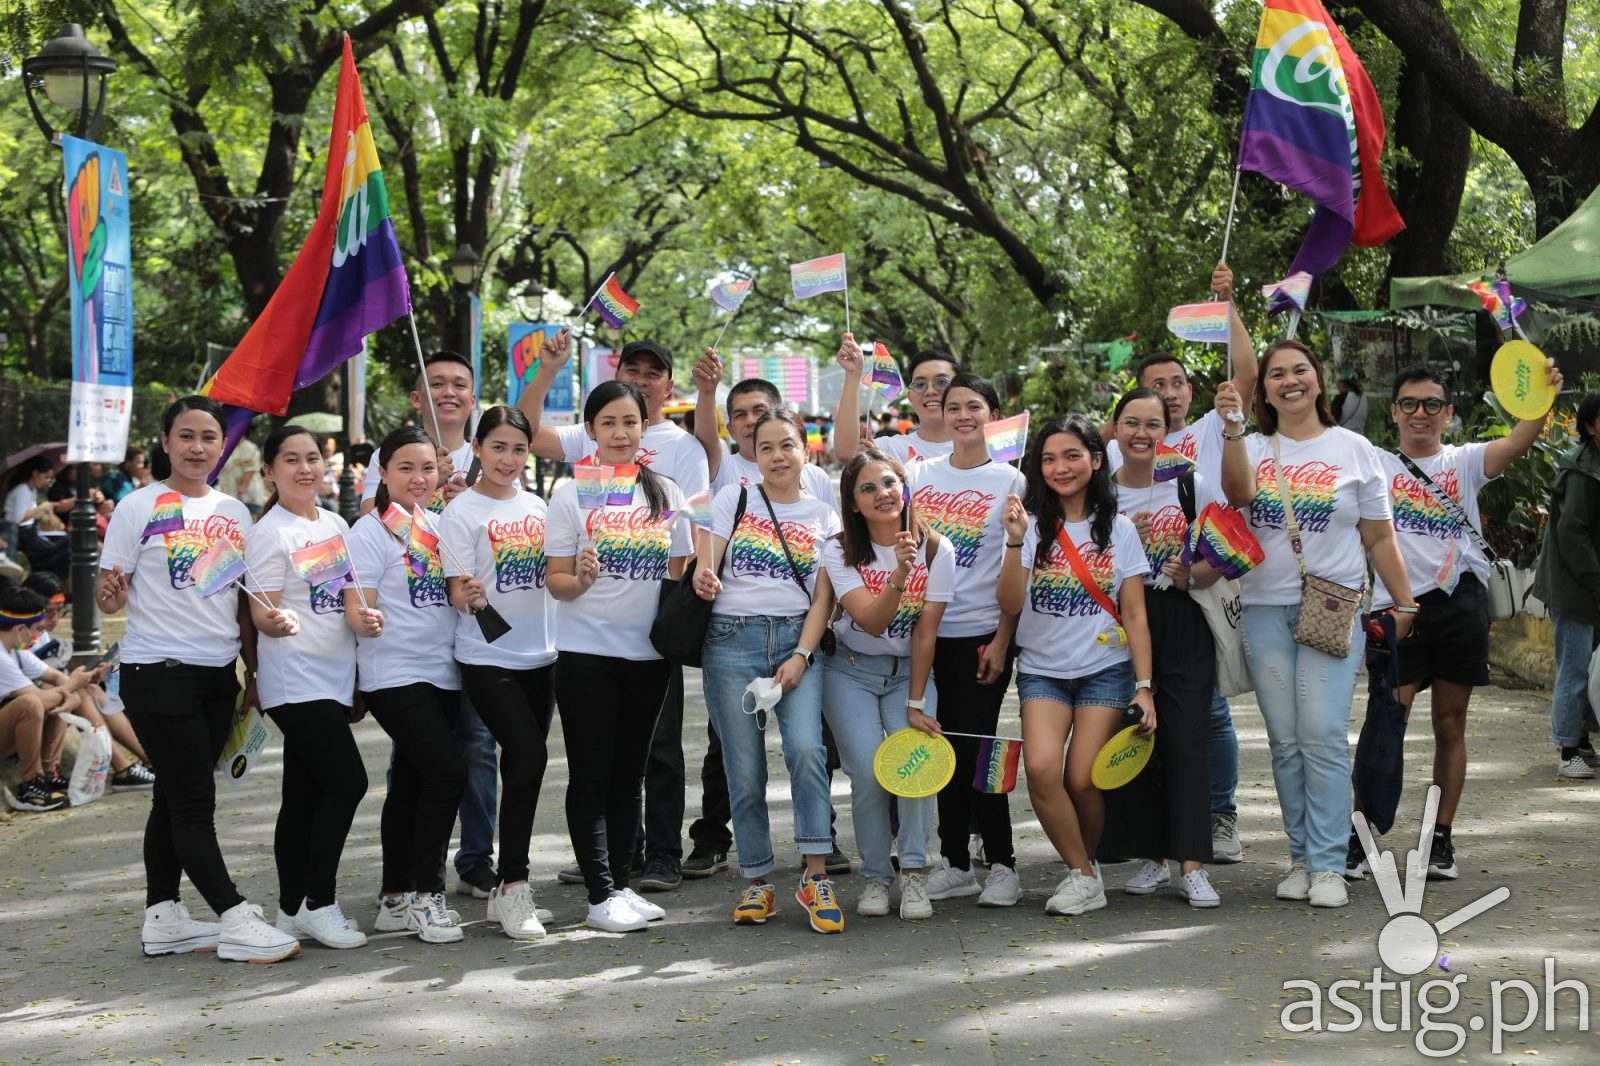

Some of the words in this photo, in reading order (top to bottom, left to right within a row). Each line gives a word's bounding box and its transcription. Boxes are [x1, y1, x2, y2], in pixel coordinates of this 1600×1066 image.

[1256, 458, 1343, 485] Coa-Cola
[488, 515, 544, 542] Coca-Co
[896, 744, 930, 779] Sprite
